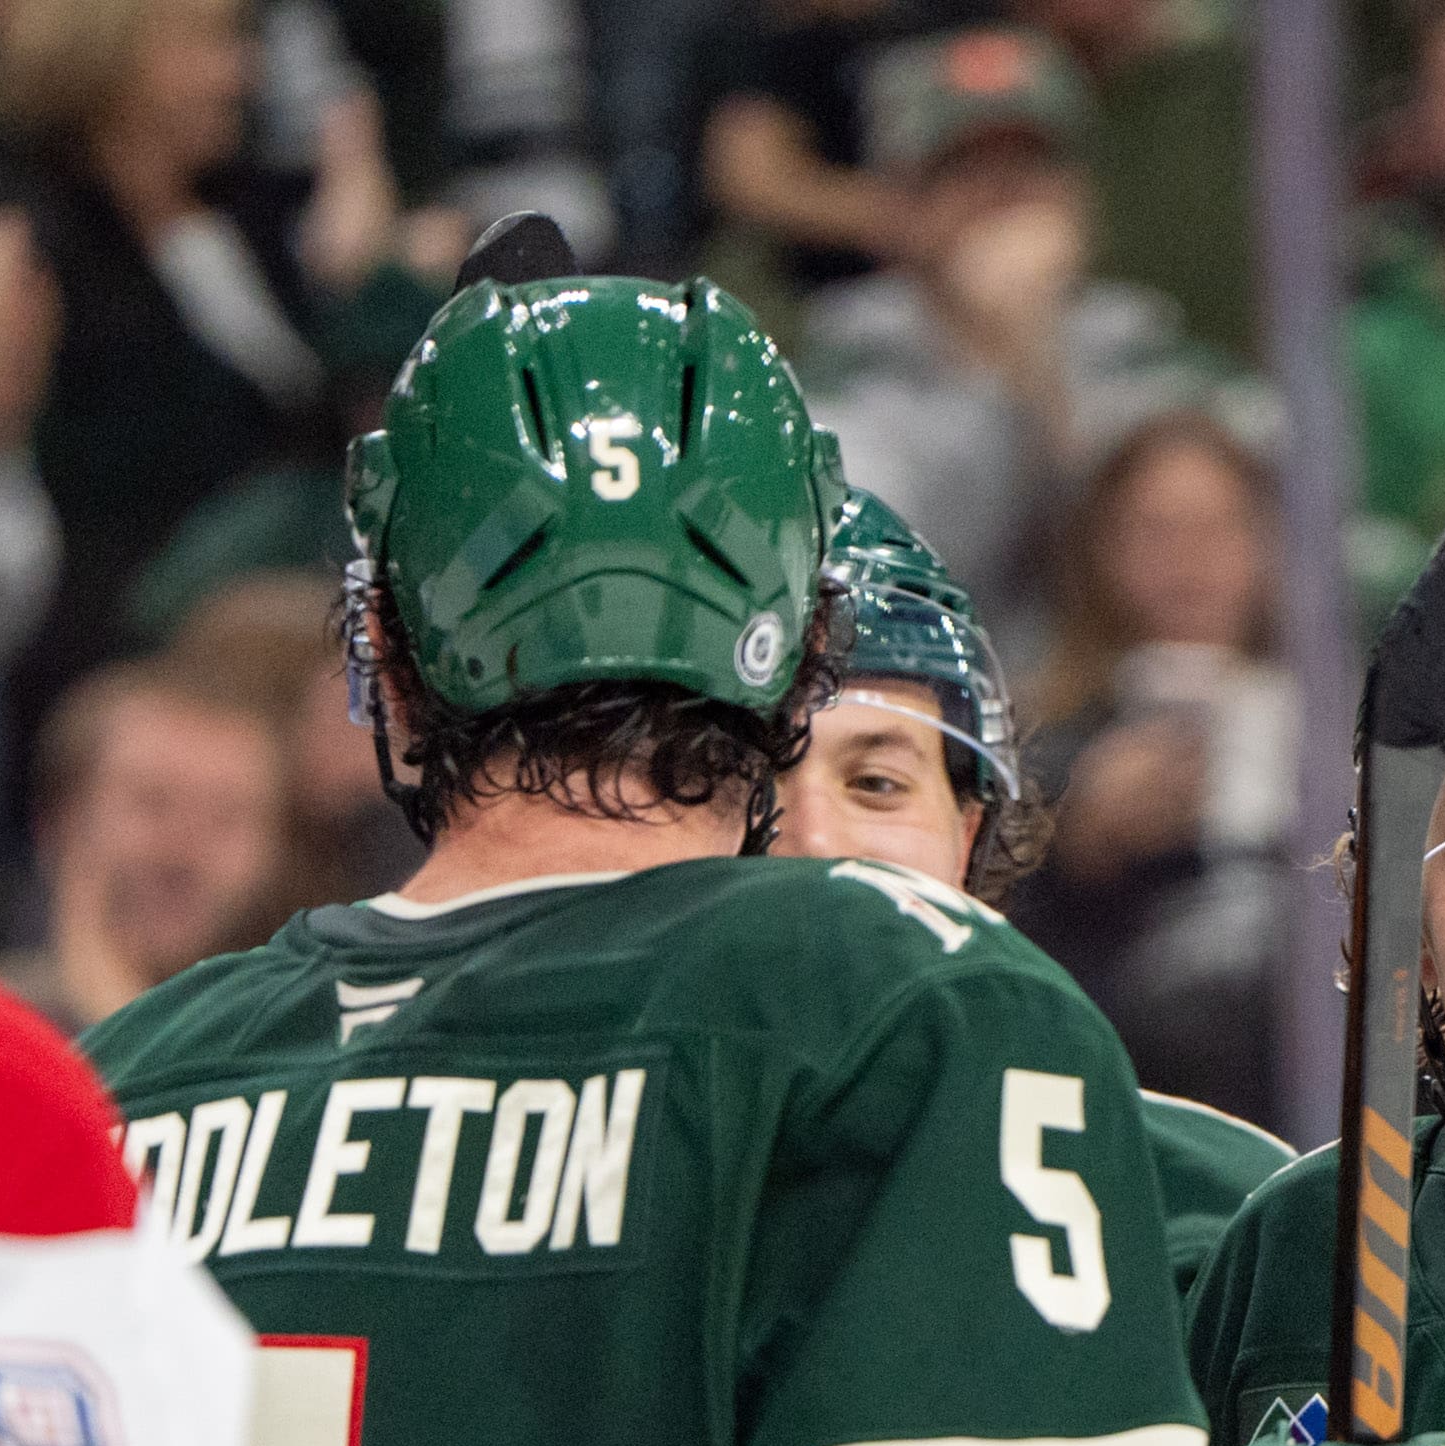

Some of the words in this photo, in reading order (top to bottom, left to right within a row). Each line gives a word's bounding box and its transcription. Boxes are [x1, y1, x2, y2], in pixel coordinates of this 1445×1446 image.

[588, 417, 641, 501] 5
[111, 1069, 646, 1264] DDLETON
[1000, 1067, 1111, 1332] 5
